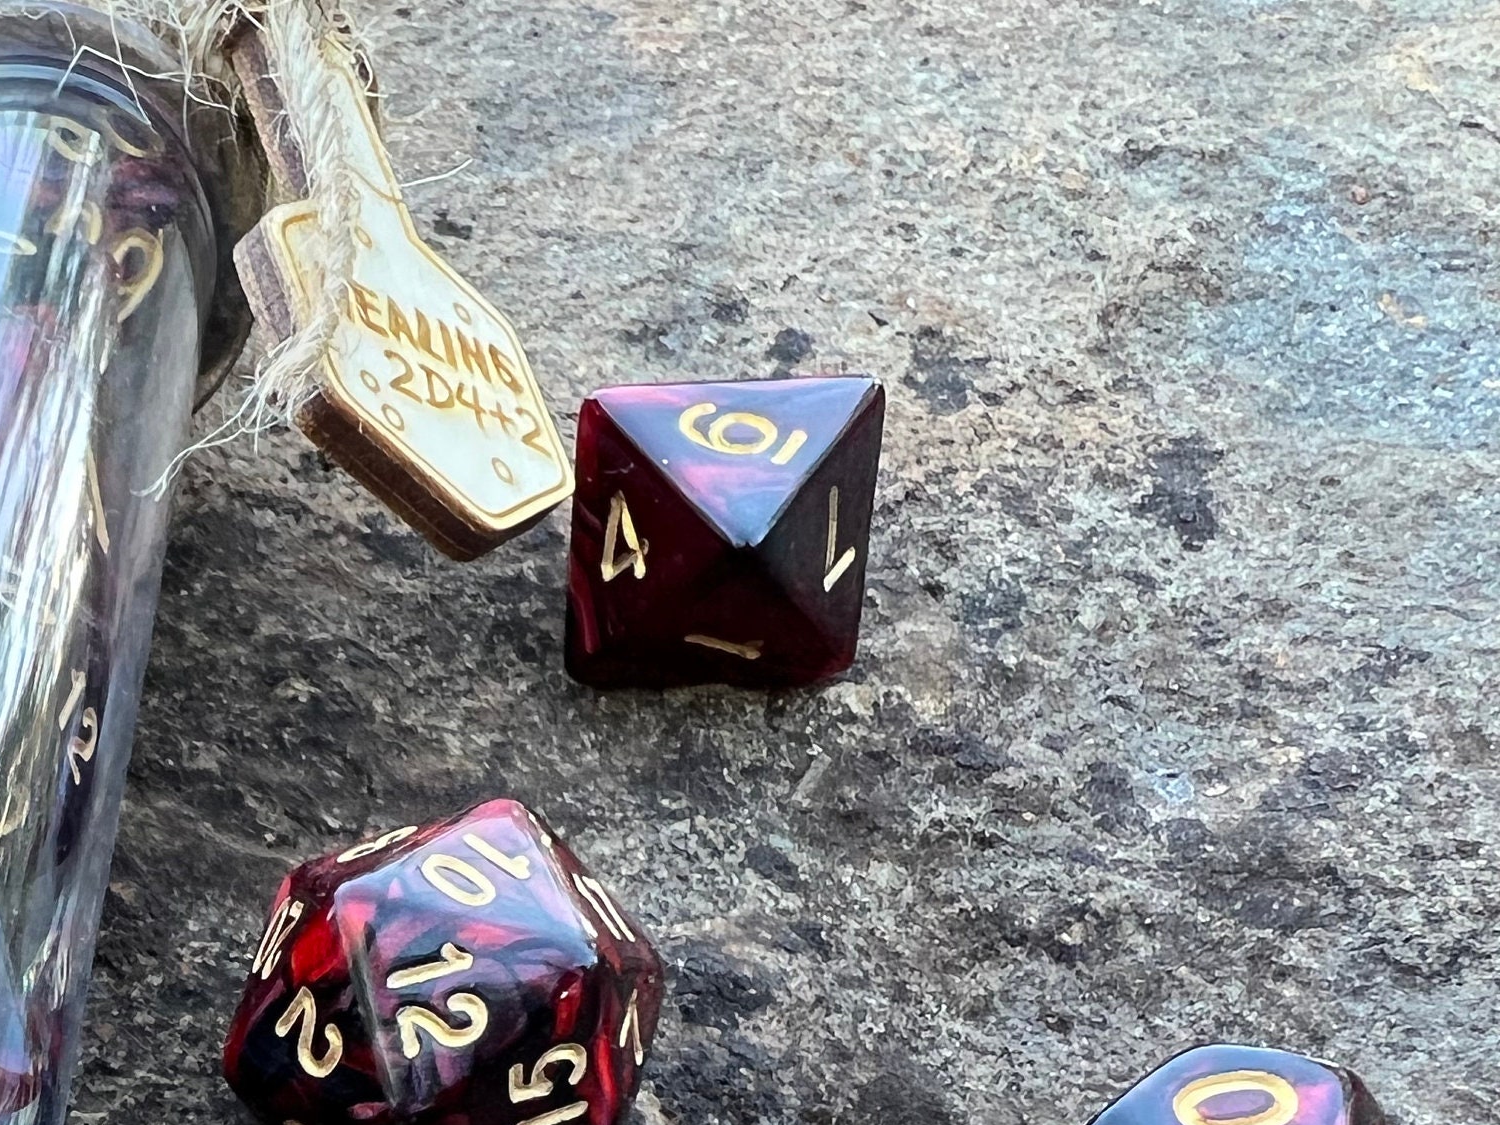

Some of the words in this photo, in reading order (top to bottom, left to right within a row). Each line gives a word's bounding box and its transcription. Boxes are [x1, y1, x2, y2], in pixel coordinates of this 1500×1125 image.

[382, 348, 552, 457] 2D4+2
[677, 402, 809, 466] 6
[600, 489, 650, 583] 4
[419, 832, 531, 907] 10
[274, 986, 344, 1079] 2
[386, 941, 489, 1060] 12
